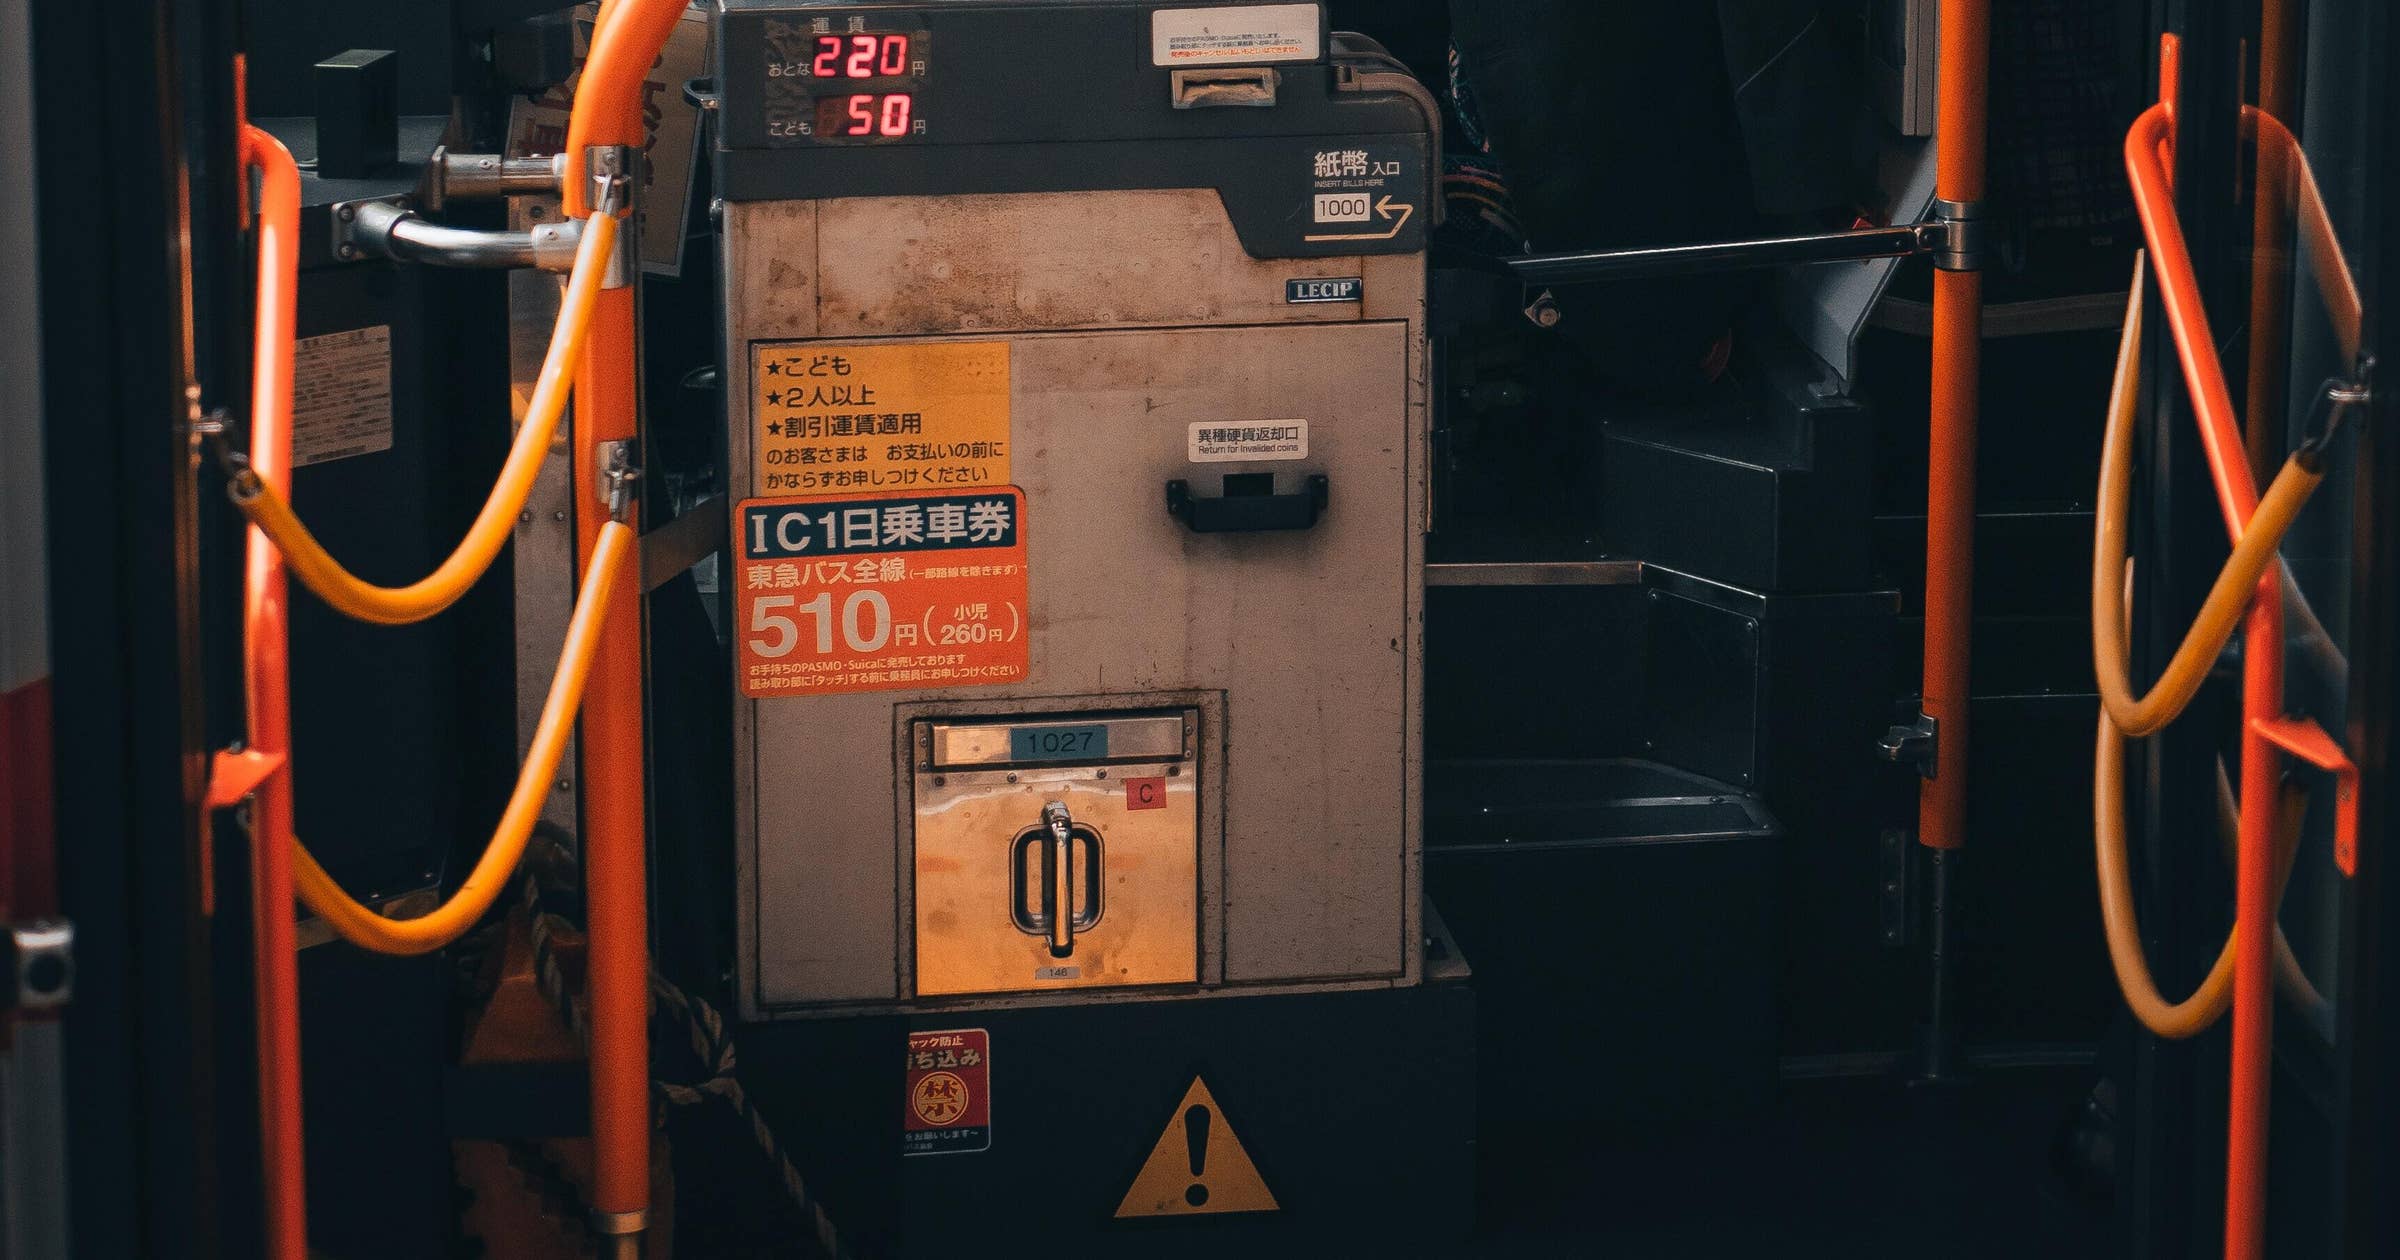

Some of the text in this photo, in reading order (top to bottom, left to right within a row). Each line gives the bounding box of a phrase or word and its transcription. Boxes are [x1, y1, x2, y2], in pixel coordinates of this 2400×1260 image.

[768, 35, 926, 78] おとな 220 円
[770, 95, 926, 136] こども 50 円
[1315, 180, 1340, 188] INSERT
[1365, 178, 1385, 186] HERE
[1320, 199, 1365, 216] 1000
[1297, 282, 1353, 298] LECIP
[1198, 445, 1226, 454] Return
[1227, 444, 1238, 453] for
[1277, 443, 1299, 452] coins
[766, 466, 988, 489] かならずお申しつけください
[1028, 732, 1093, 753] 1027
[1139, 783, 1153, 803] C
[907, 1048, 981, 1070] ち込み
